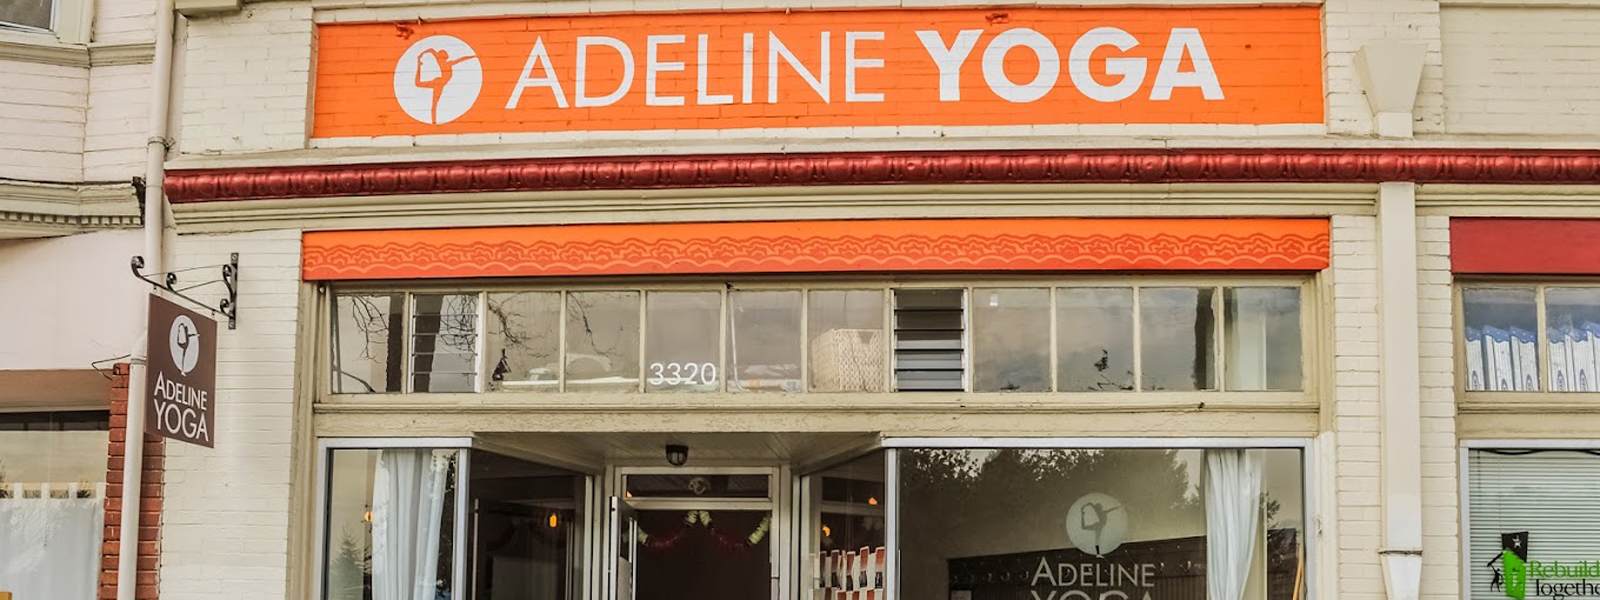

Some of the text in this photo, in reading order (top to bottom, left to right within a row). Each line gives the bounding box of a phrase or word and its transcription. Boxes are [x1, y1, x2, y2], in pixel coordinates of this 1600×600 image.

[504, 26, 1225, 109] ADELINE YOGA
[153, 370, 208, 411] ADELINE
[649, 362, 716, 386] 3320
[153, 398, 209, 442] YOGA
[1030, 556, 1157, 588] ADELINE
[1529, 560, 1600, 578] Rebuild
